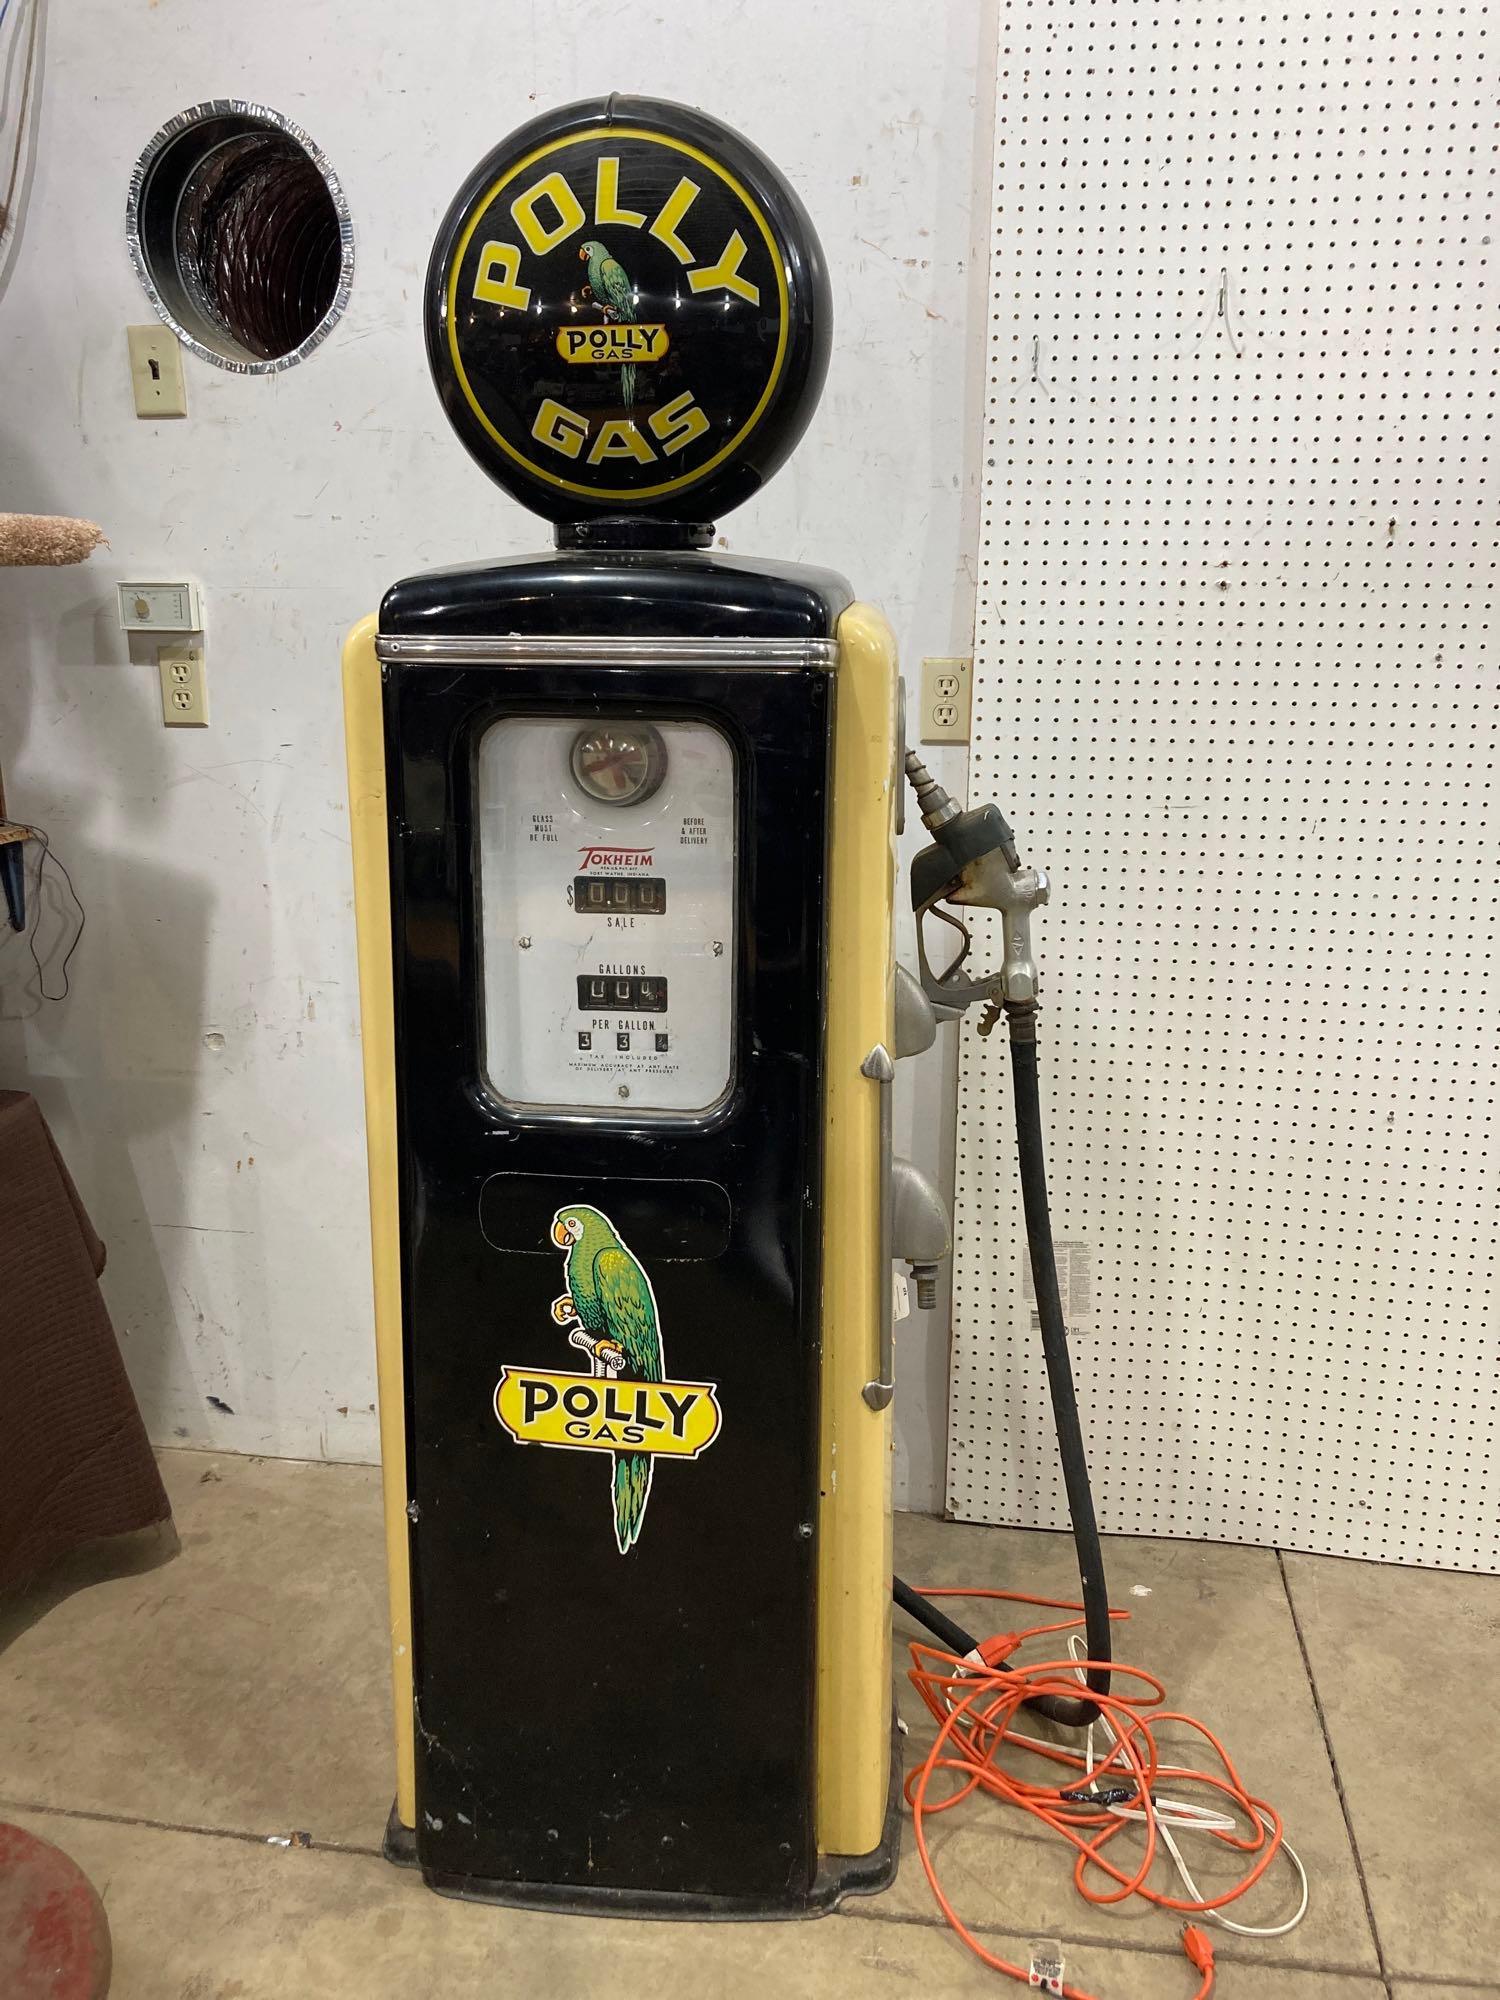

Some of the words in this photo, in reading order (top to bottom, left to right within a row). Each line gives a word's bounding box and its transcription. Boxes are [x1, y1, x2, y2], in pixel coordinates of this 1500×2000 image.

[472, 157, 760, 311] POLLY
[567, 328, 659, 355] POLLY
[592, 349, 633, 360] GAS
[531, 390, 710, 465] GAS
[532, 814, 553, 822] GLASS
[683, 818, 704, 826] BEFORE
[530, 834, 538, 842] BE
[542, 834, 558, 842] FULL
[680, 836, 708, 844] DELIVERY
[577, 846, 656, 870] TOKHEIM
[567, 884, 574, 907] $
[608, 917, 634, 928] SALE
[598, 964, 646, 975] GALLONS
[592, 1020, 609, 1030] PER
[618, 1020, 654, 1030] GALLON
[581, 1034, 590, 1047] 3
[620, 1034, 628, 1048] 3
[520, 1380, 699, 1437] POLLY
[564, 1421, 645, 1444] GAS
